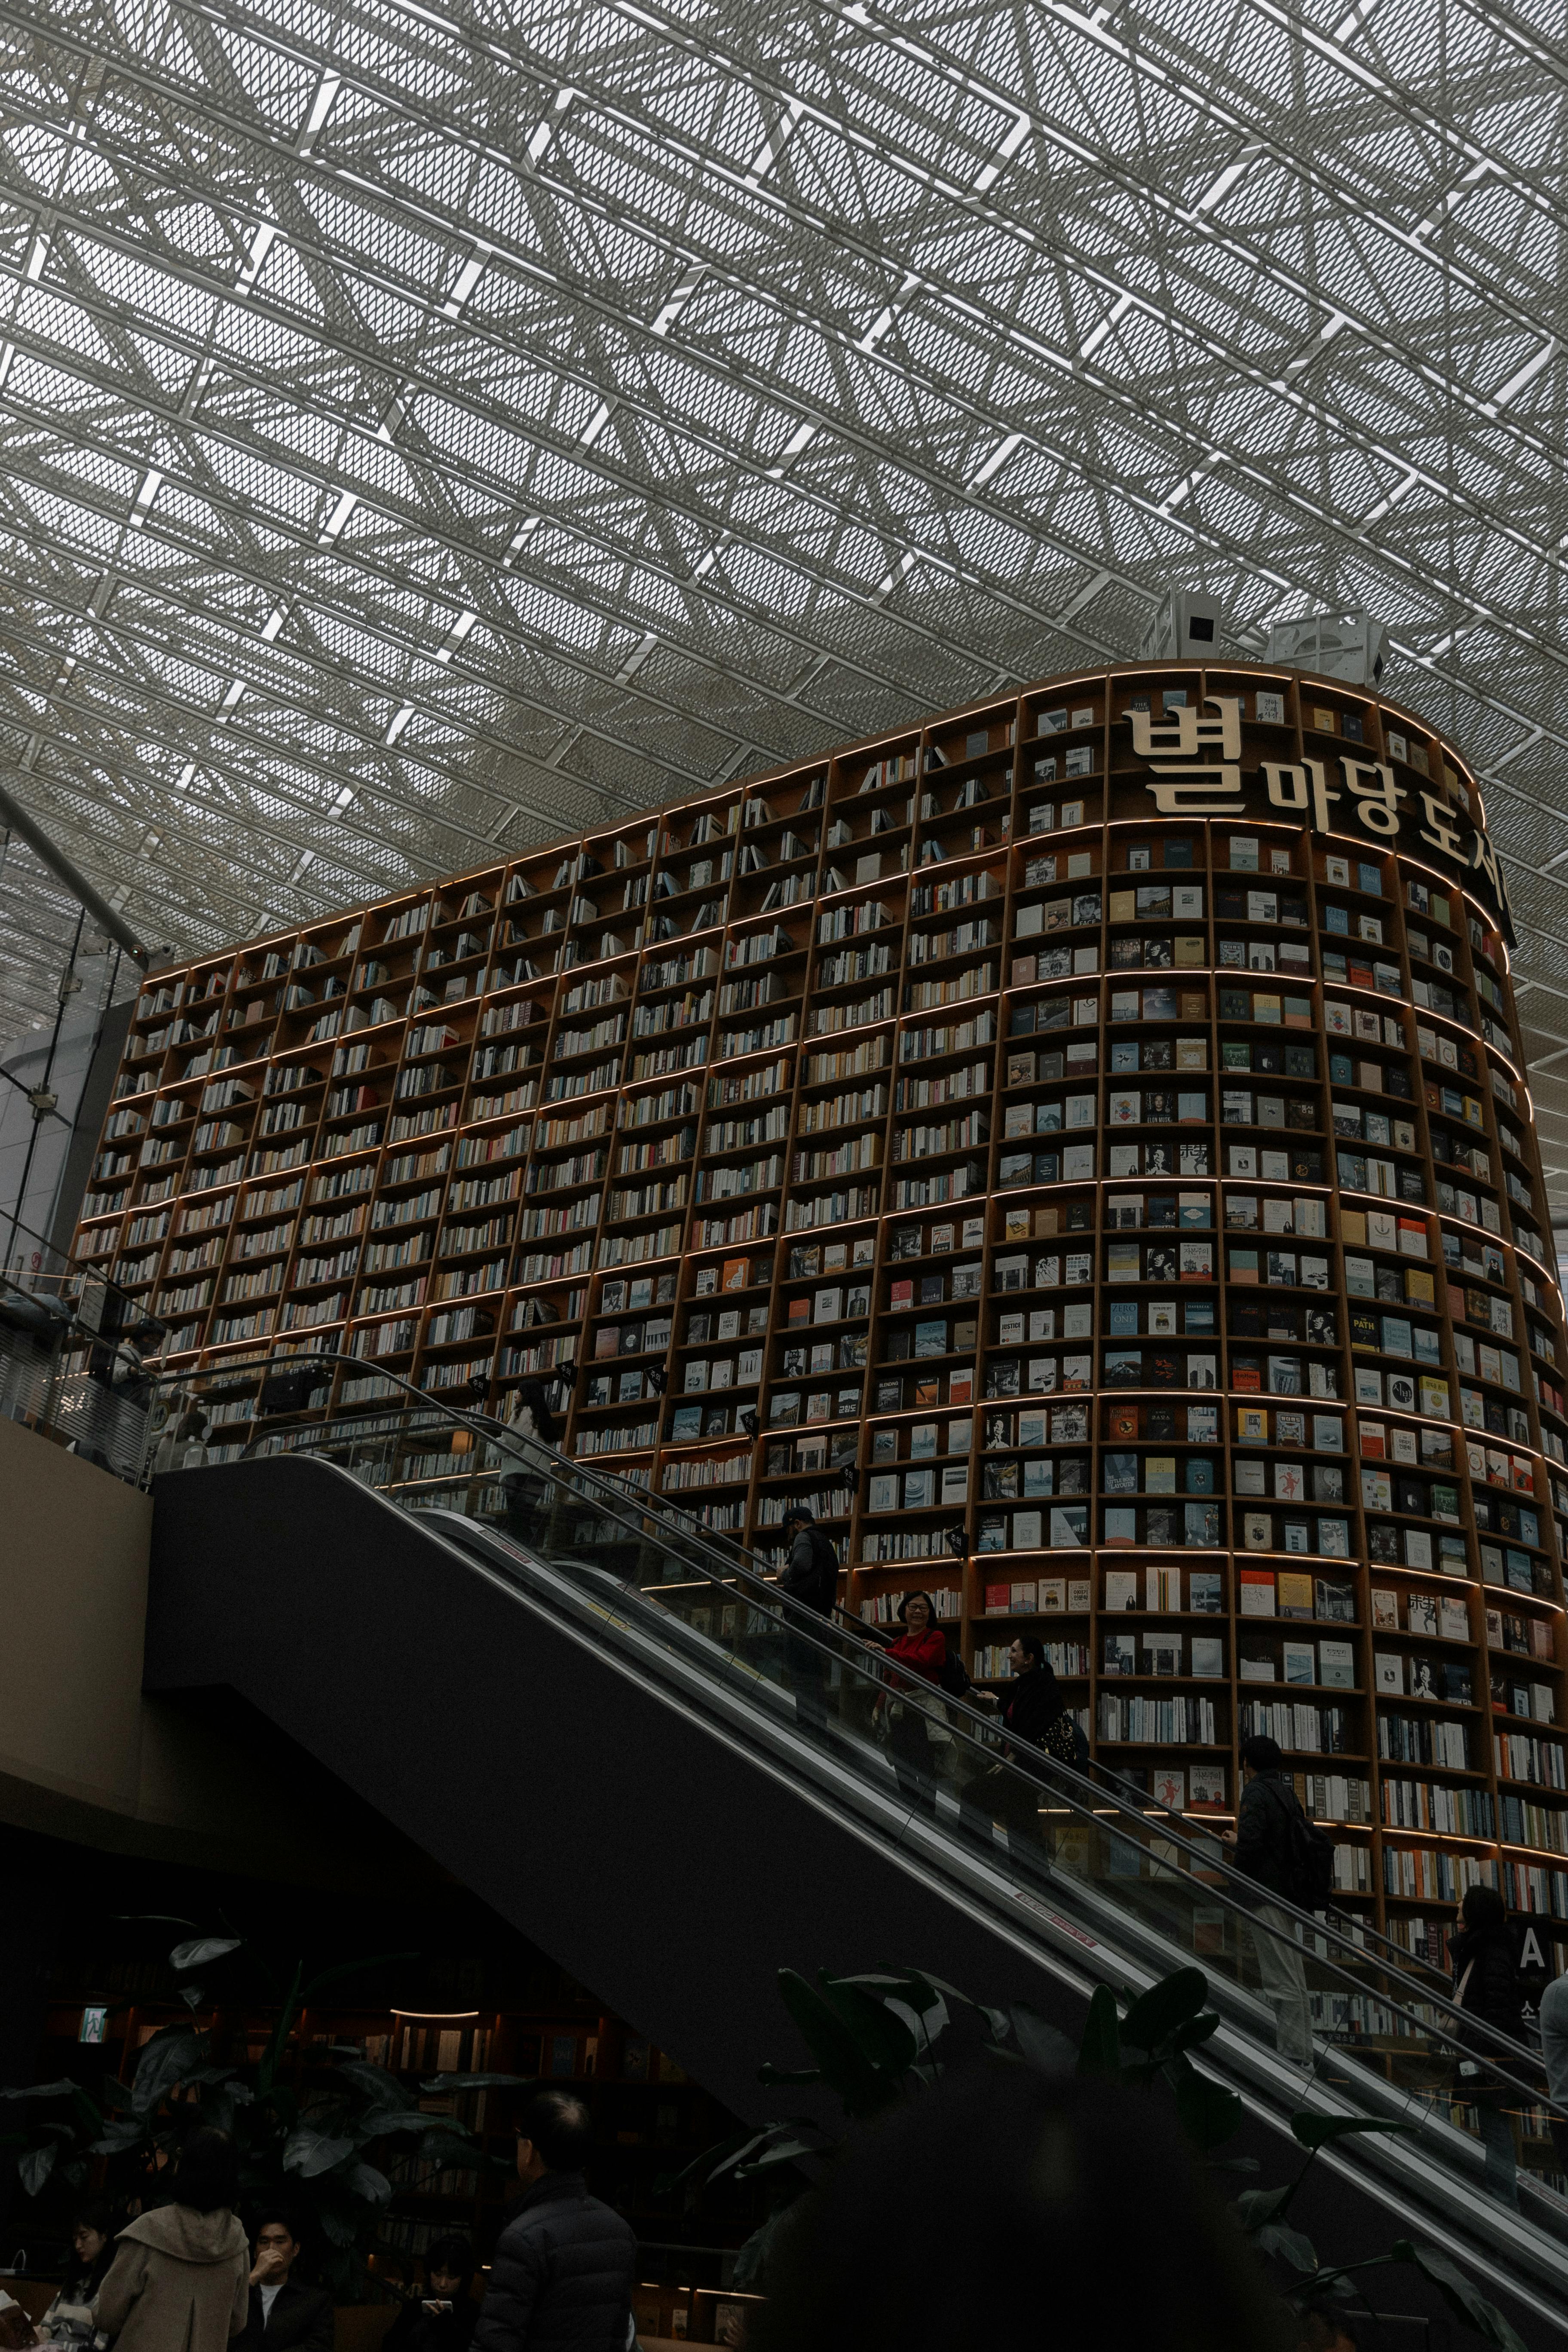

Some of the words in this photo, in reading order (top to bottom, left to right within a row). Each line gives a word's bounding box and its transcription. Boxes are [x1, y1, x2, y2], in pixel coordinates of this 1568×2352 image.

[1361, 864, 1380, 875] ZERO
[1363, 875, 1377, 885] ONE
[1327, 908, 1347, 918] ZERO
[1329, 917, 1344, 926] ONE
[1184, 1247, 1209, 1255] 자본주의
[1354, 1320, 1375, 1330] PATH
[561, 1364, 571, 1376] 주의
[650, 1370, 661, 1382] 주의
[473, 1378, 484, 1390] 주의
[839, 1404, 856, 1414] 군함도
[744, 1415, 753, 1427] 주의
[844, 1468, 853, 1480] 주의
[951, 1533, 961, 1547] 주의
[1194, 1771, 1221, 1781] 자본주의
[1519, 1927, 1546, 1968] A
[1521, 2000, 1541, 2019] 소
